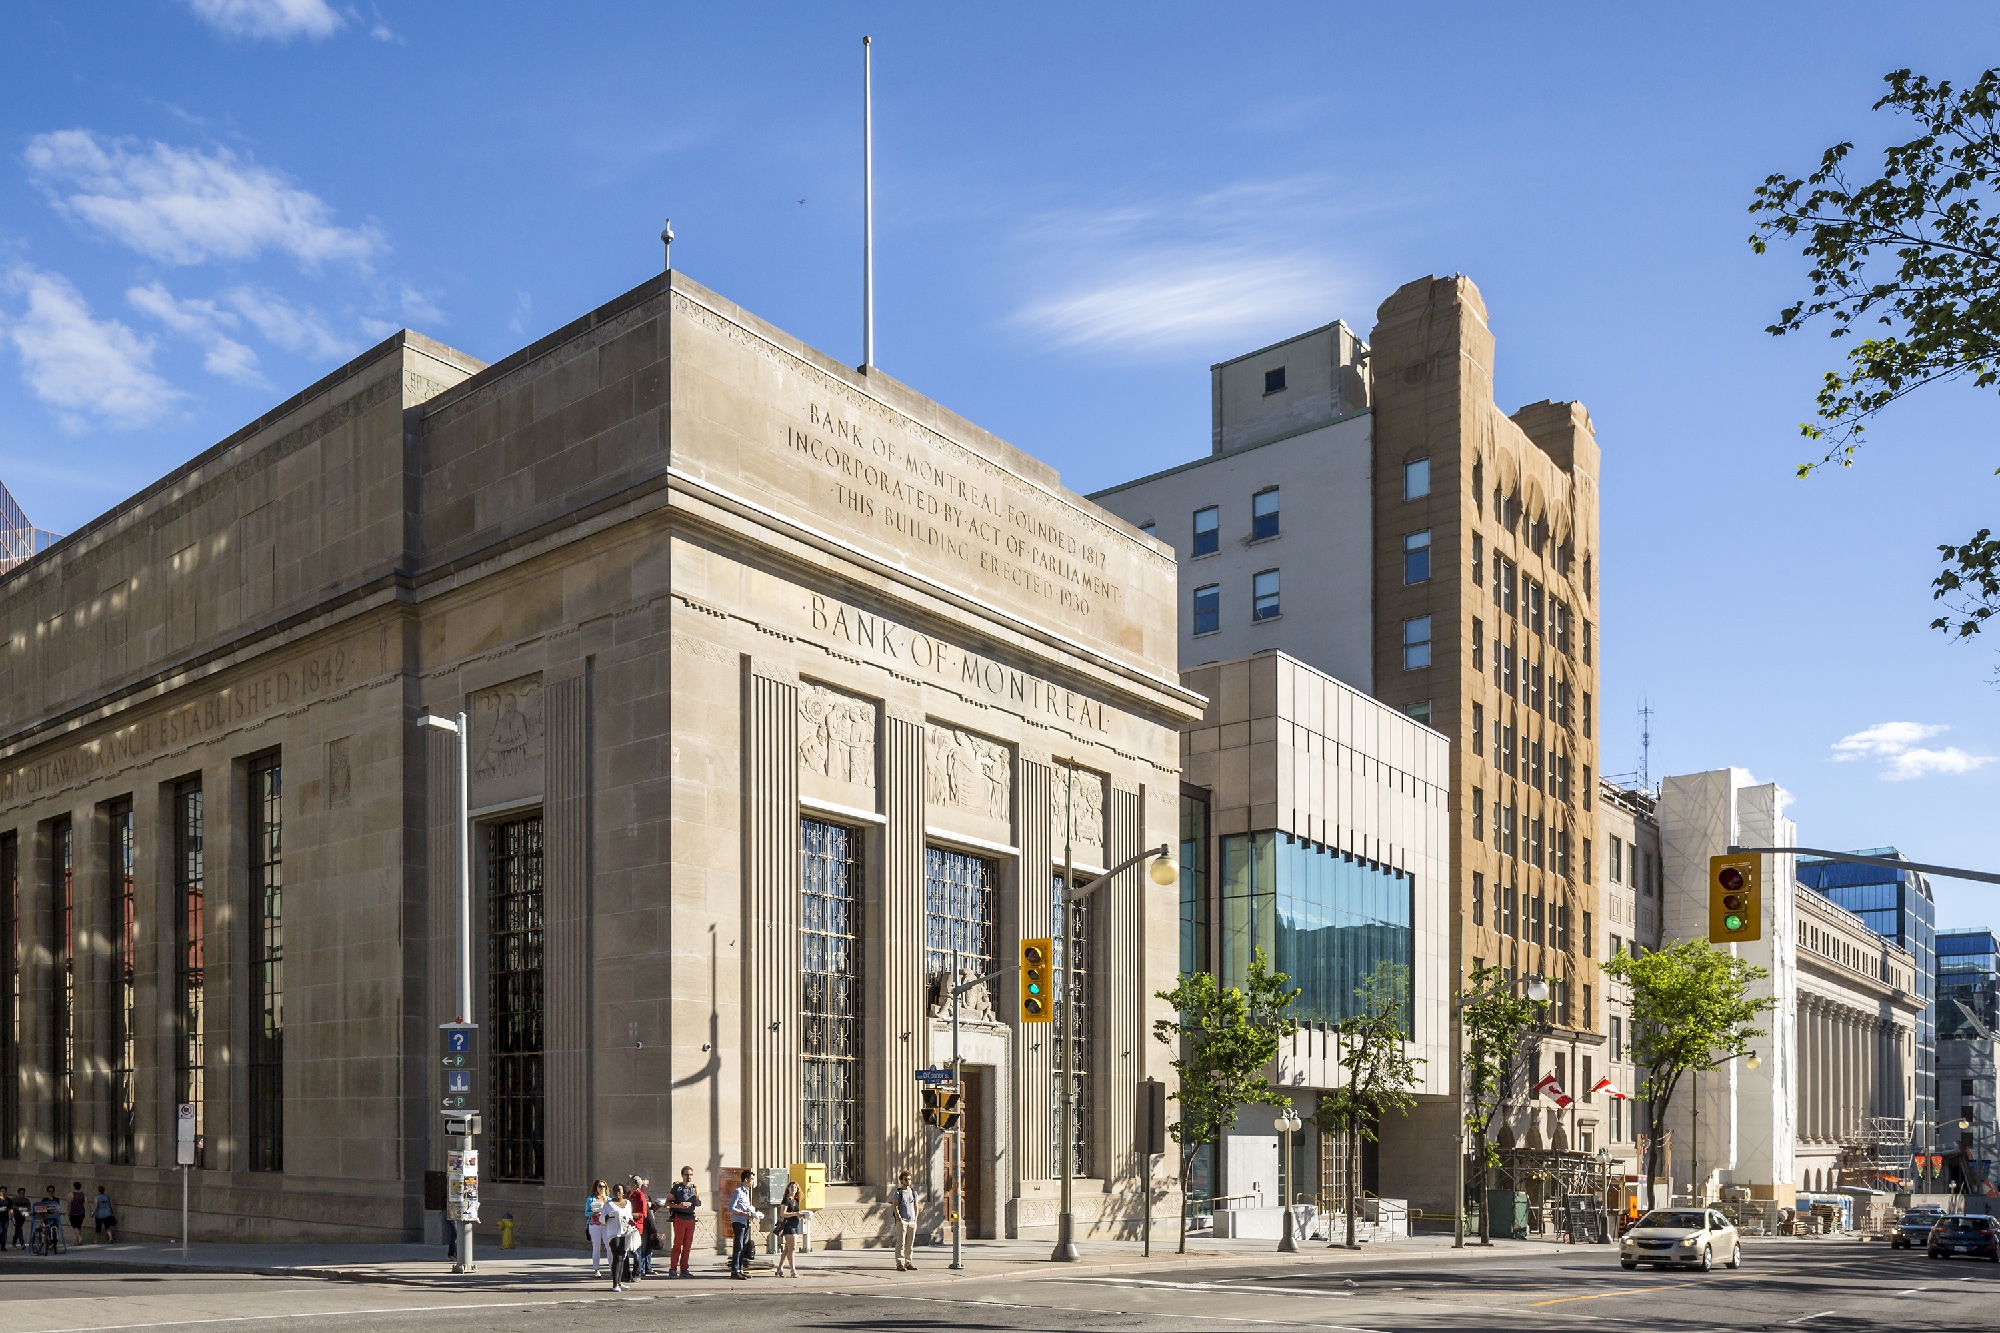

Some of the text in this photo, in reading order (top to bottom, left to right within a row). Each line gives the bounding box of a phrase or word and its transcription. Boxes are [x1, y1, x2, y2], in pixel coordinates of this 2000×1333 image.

[788, 426, 1119, 603] INCORPORATED BY ACT OF PARLIAMENT
[810, 402, 1106, 570] BANK OF MONTREAL FOUNDED 1817
[835, 482, 1090, 616] THIS BUILDING ERECTED 1930
[26, 752, 80, 793] OTTAWA
[85, 723, 151, 773] BRANCH
[159, 671, 290, 747] ESTABLISHED
[302, 649, 346, 696] 1842
[810, 592, 1109, 735] BANK OF MONTREAL
